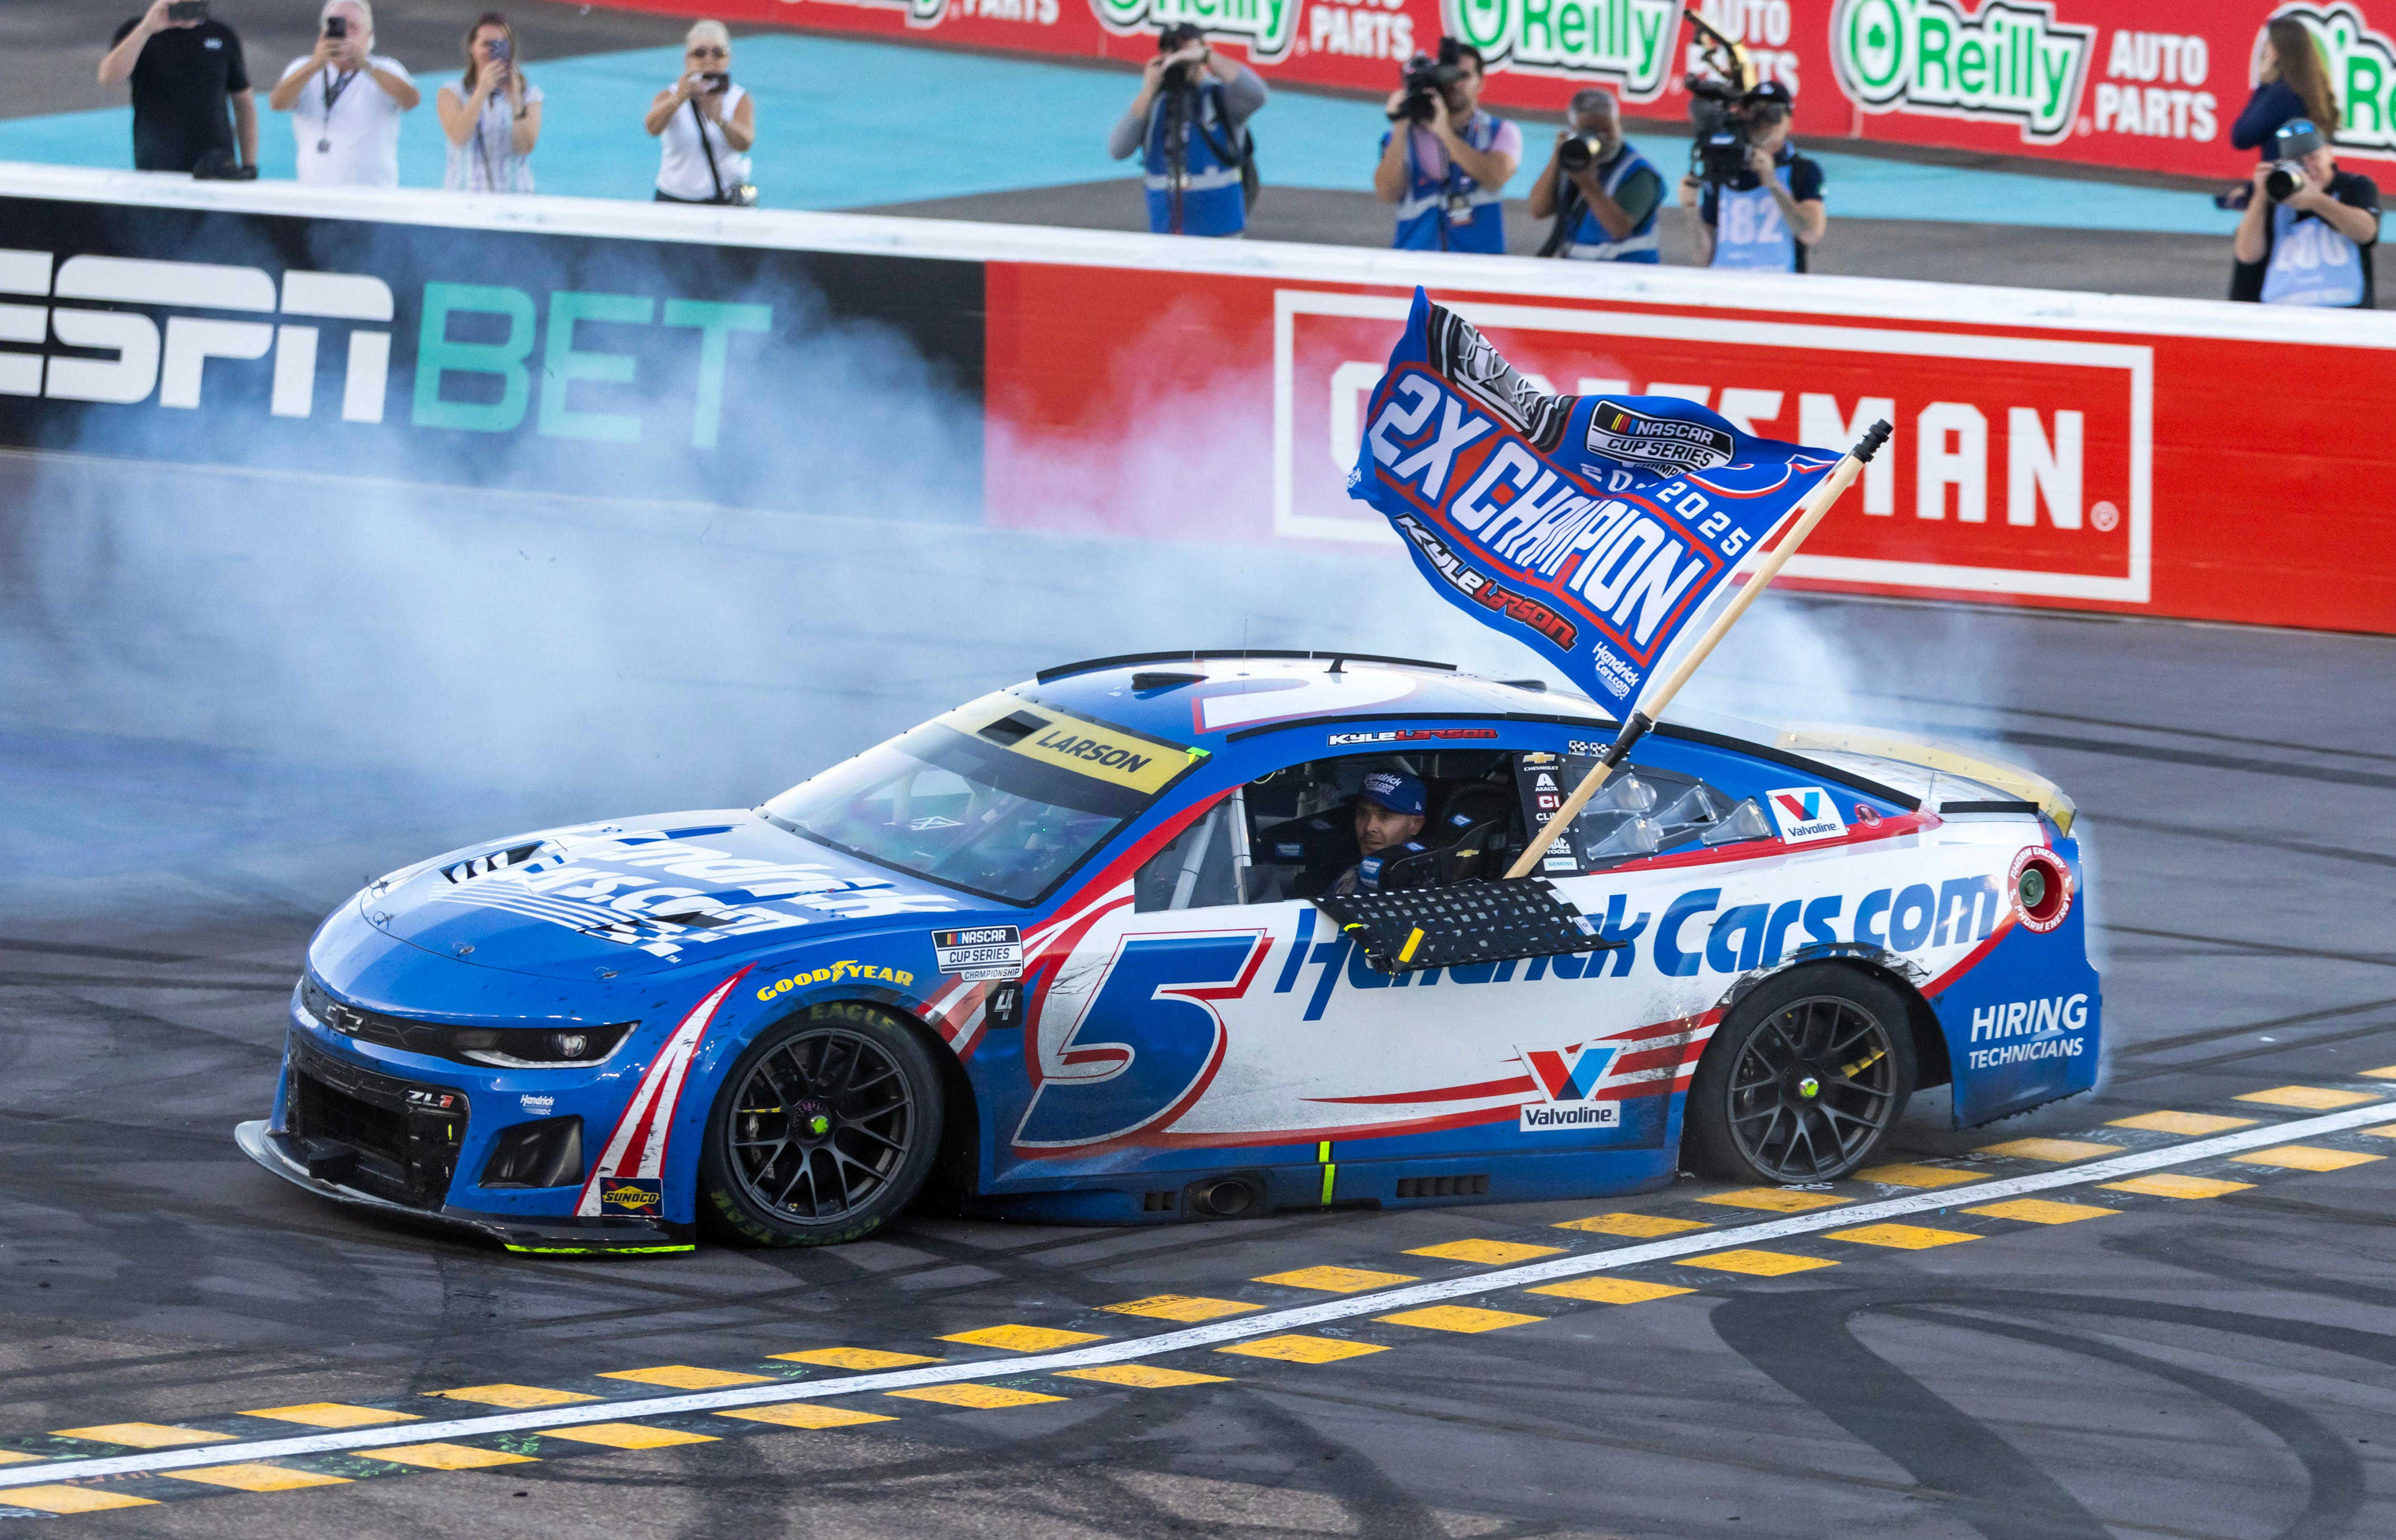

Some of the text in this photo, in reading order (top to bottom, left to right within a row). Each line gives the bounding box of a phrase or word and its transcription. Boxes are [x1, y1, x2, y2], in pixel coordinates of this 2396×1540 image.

[1310, 6, 1414, 61] PARTS
[1849, 0, 2070, 117] O'Reilly
[2107, 31, 2209, 87] AUTO
[2093, 84, 2218, 143] PARTS
[411, 281, 773, 449] BET
[1367, 373, 1493, 502] 2X
[1635, 421, 1714, 445] NASCAR
[1606, 438, 1714, 467] CUP SERIES
[1656, 481, 1752, 557] 2025
[1592, 640, 1640, 687] Hendrick
[1595, 660, 1630, 697] Cars.com
[1036, 730, 1153, 773] LARSON
[1787, 823, 1837, 837] Valvoline
[2032, 847, 2066, 869] ENERGY
[2044, 893, 2072, 931] ENERGY
[961, 929, 1007, 944] NASCAR
[949, 947, 1010, 963] CUP SERIES
[964, 968, 1020, 979] CHAMPIONSHIP
[994, 989, 1015, 1021] 4
[1970, 993, 2089, 1043] HIRING
[1011, 929, 1270, 1150] 5
[1968, 1037, 2084, 1070] TECHNICIANS
[405, 1089, 454, 1108] ZL1
[520, 1094, 555, 1107] Hendrick
[1525, 1106, 1612, 1126] Valvoline
[605, 1192, 658, 1203] SUNOCO
